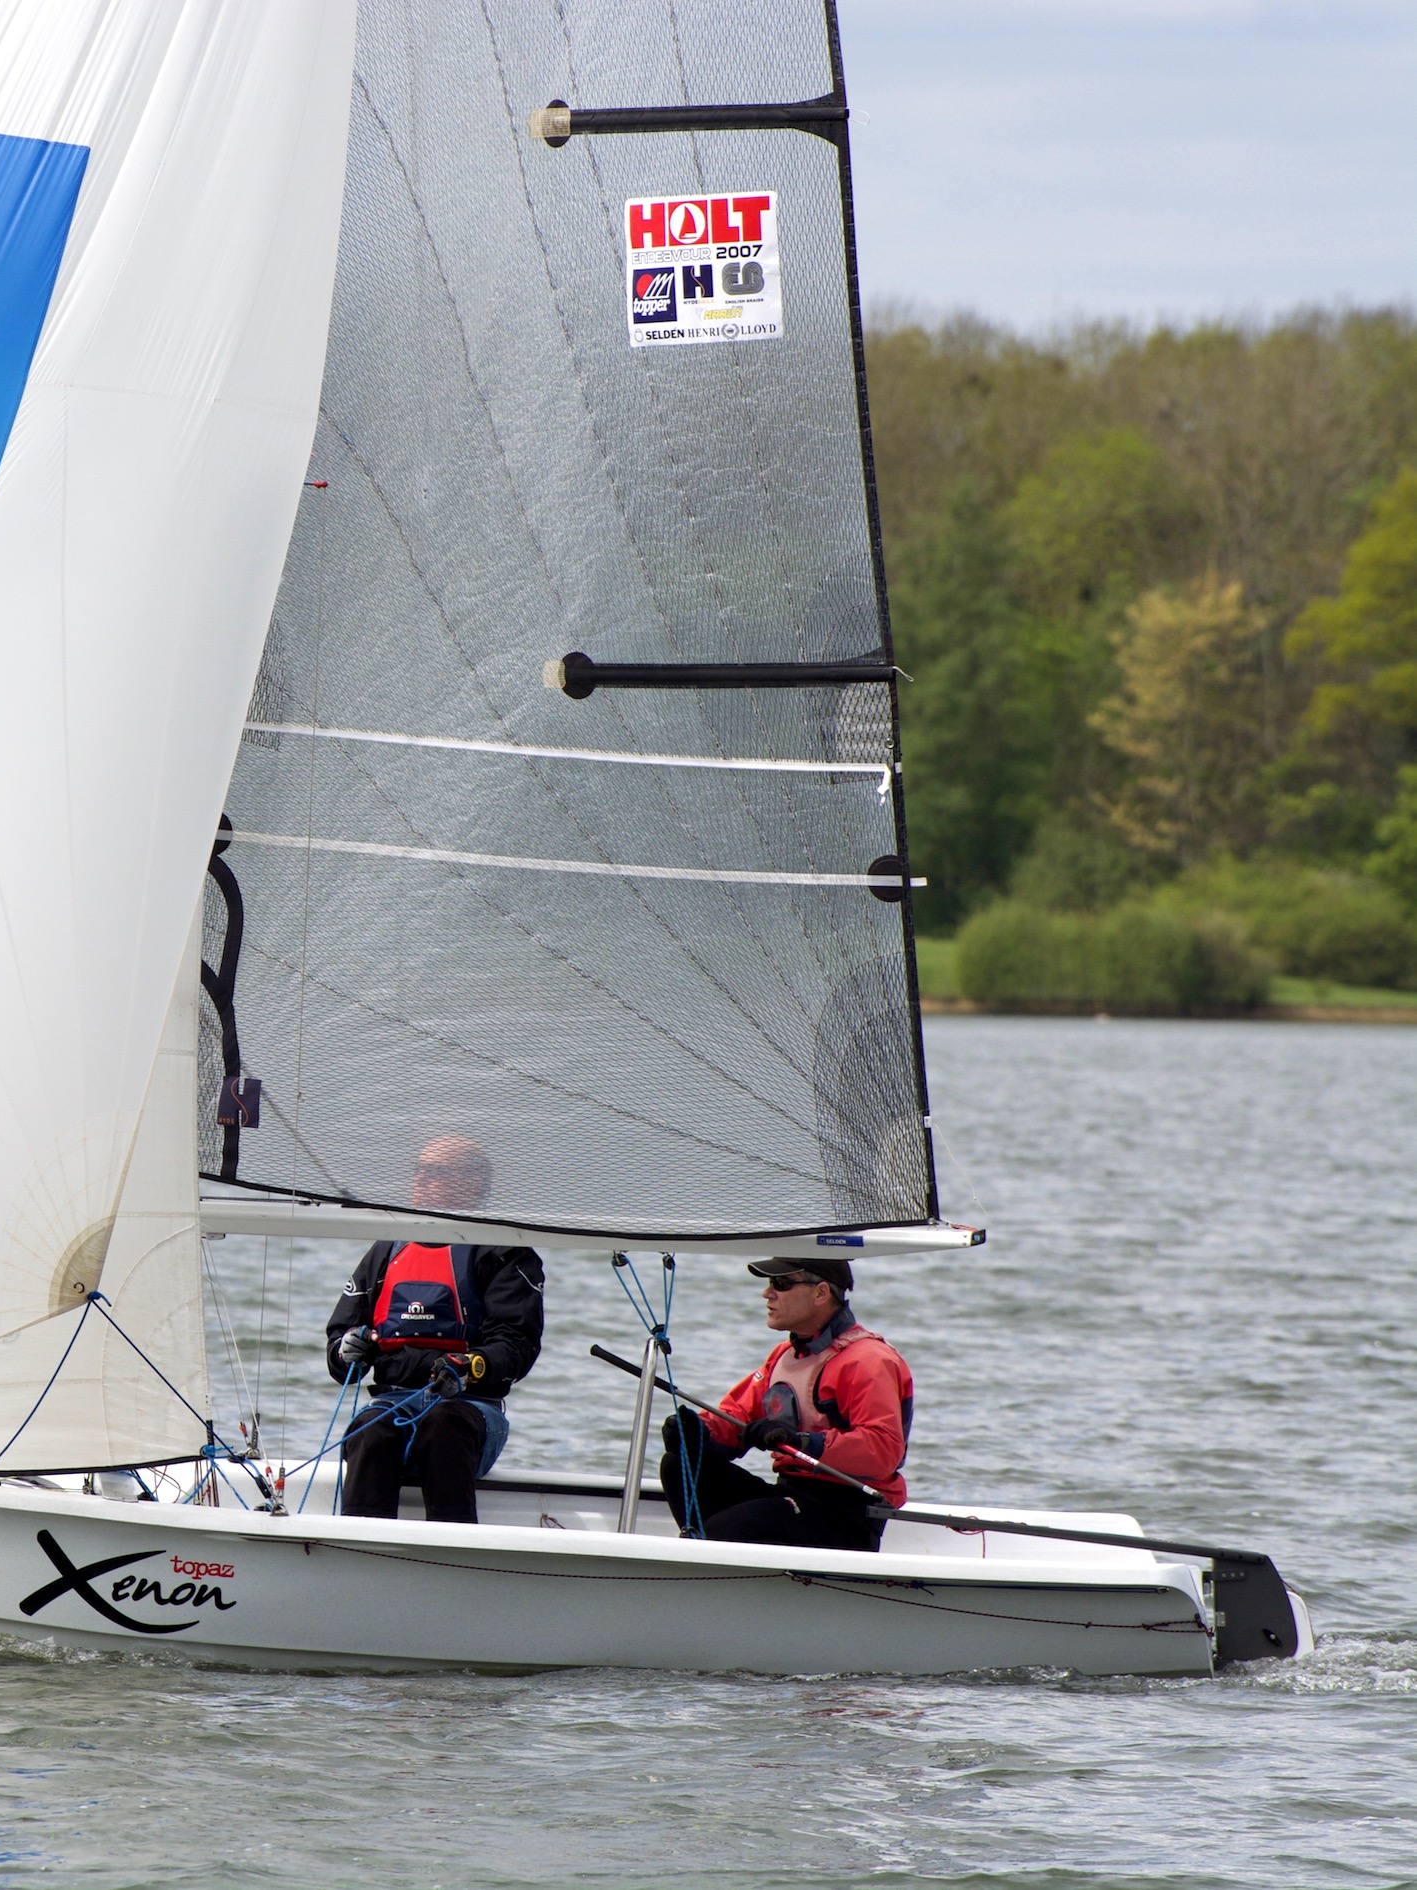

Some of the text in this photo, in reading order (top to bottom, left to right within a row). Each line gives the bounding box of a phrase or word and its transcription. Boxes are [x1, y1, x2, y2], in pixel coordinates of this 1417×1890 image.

[630, 196, 770, 249] HOLT
[716, 244, 763, 259] 2007
[633, 298, 671, 317] topper
[646, 323, 777, 341] SELDÉN HENRI LLOYD
[170, 1555, 235, 1580] topaz
[19, 1529, 237, 1634] Xenon
